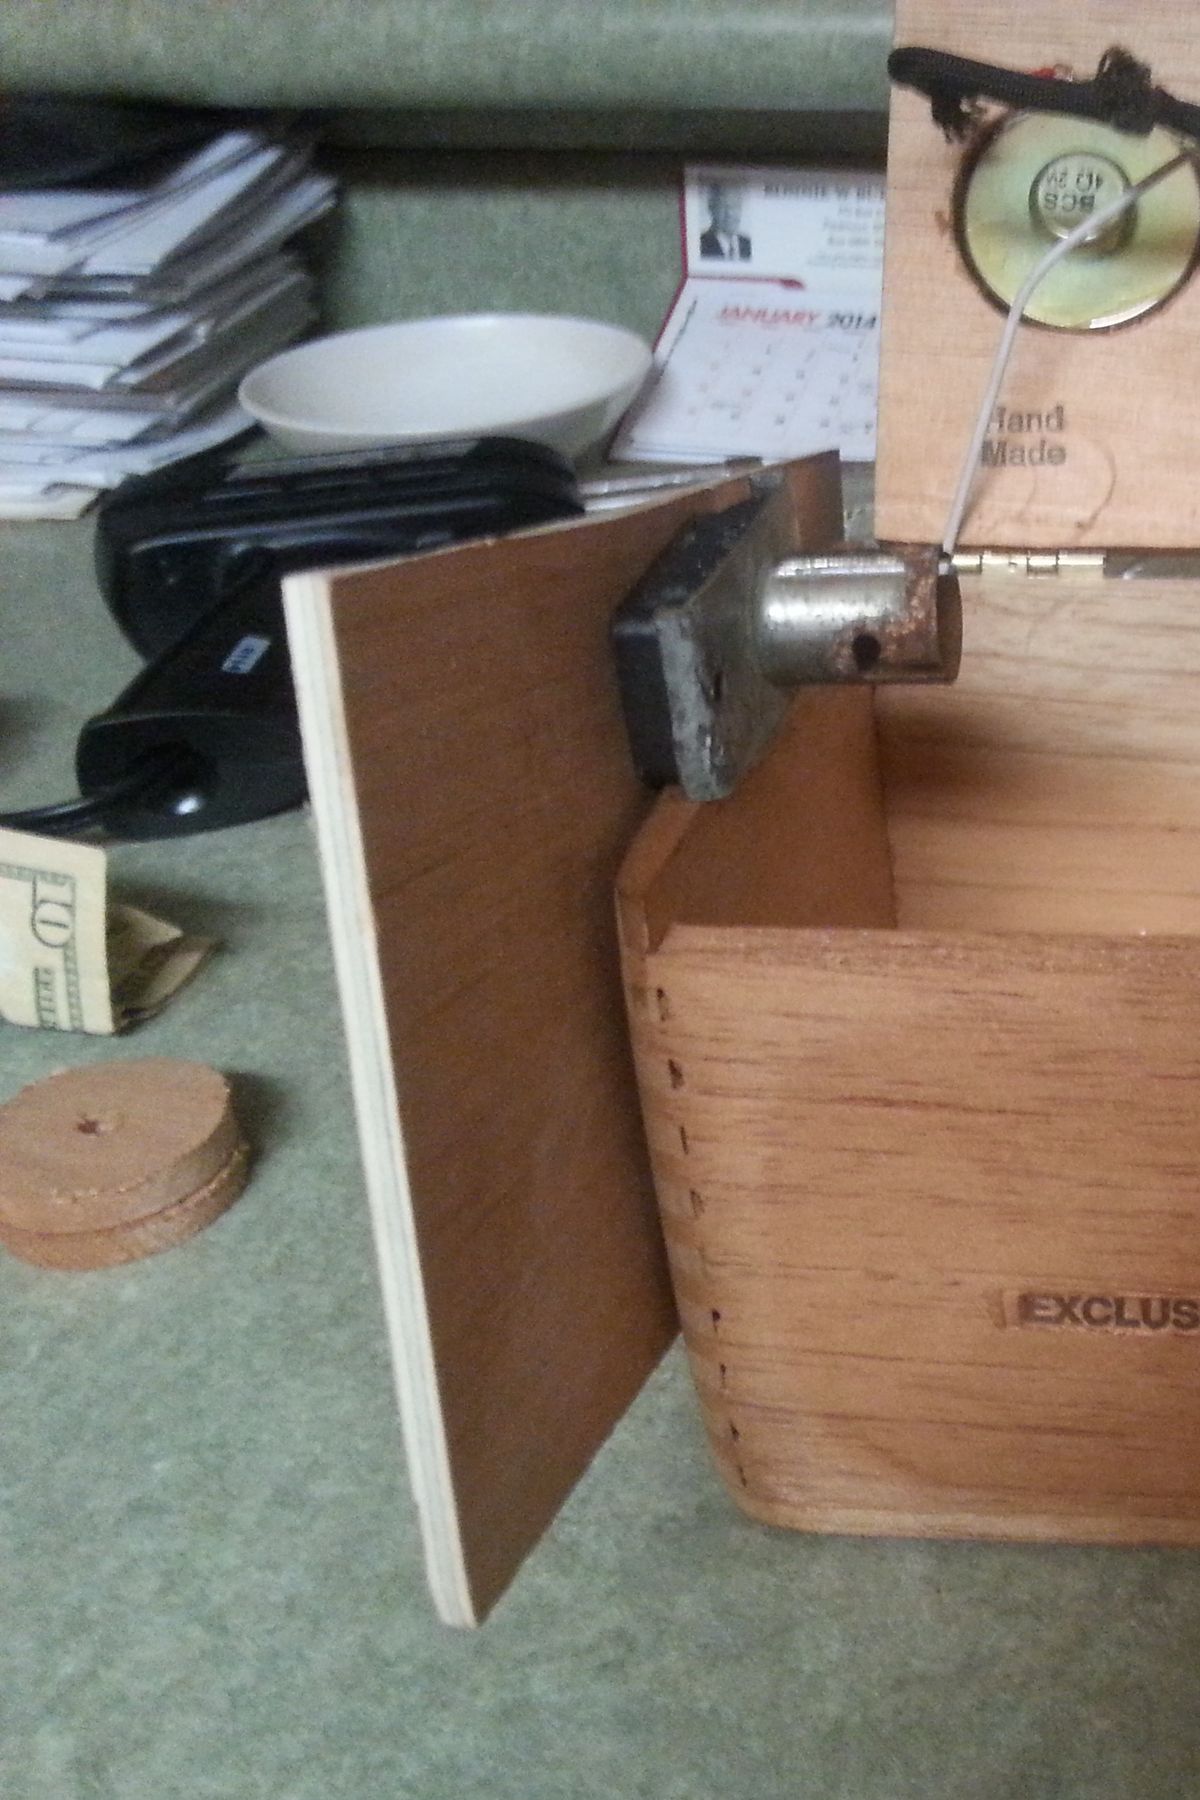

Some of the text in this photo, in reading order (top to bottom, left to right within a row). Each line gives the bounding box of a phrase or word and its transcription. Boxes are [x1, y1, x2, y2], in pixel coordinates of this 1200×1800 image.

[717, 304, 877, 330] JANUARY 2014
[985, 404, 1064, 433] Hand
[981, 440, 1067, 467] Made
